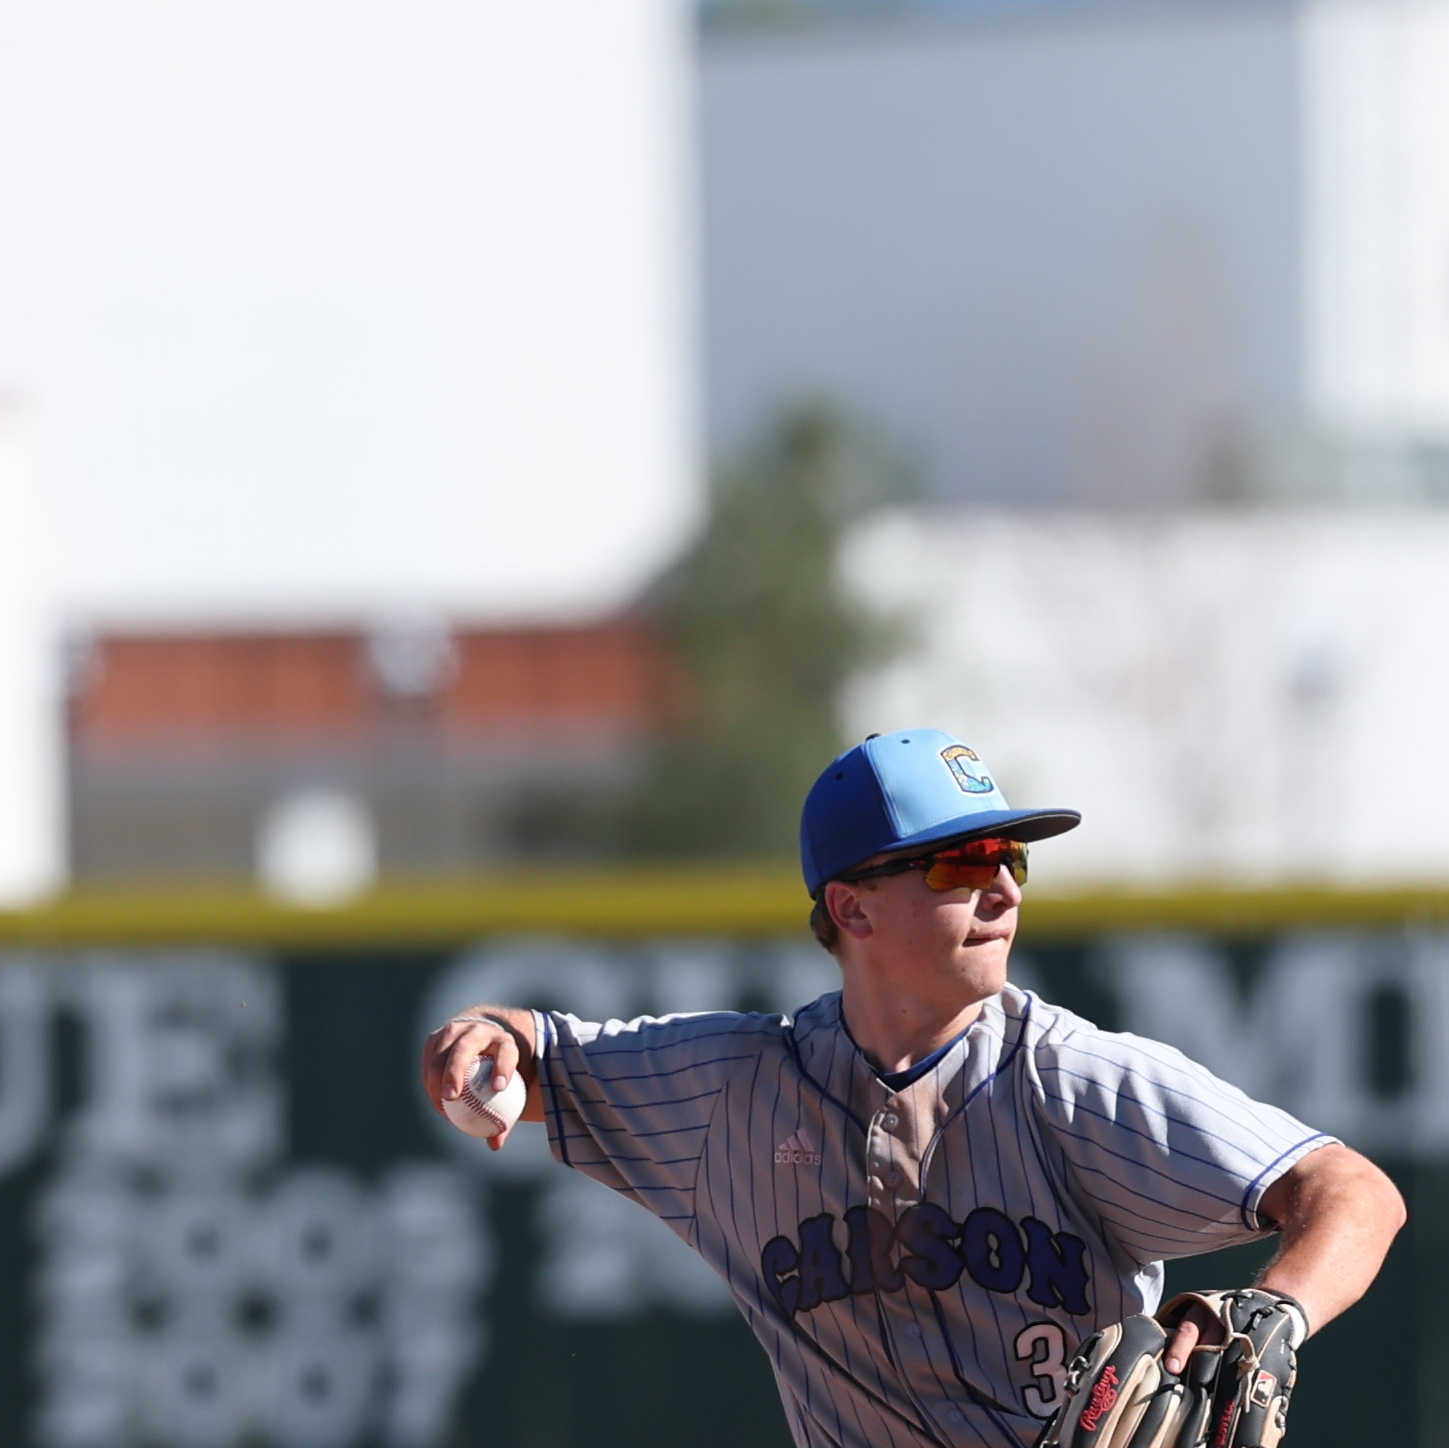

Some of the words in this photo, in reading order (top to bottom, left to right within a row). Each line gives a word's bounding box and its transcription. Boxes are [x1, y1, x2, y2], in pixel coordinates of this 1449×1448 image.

[940, 745, 995, 794] C
[775, 1151, 821, 1166] adidas
[761, 1202, 1092, 1322] CARSON
[1080, 1364, 1119, 1431] Rawlings
